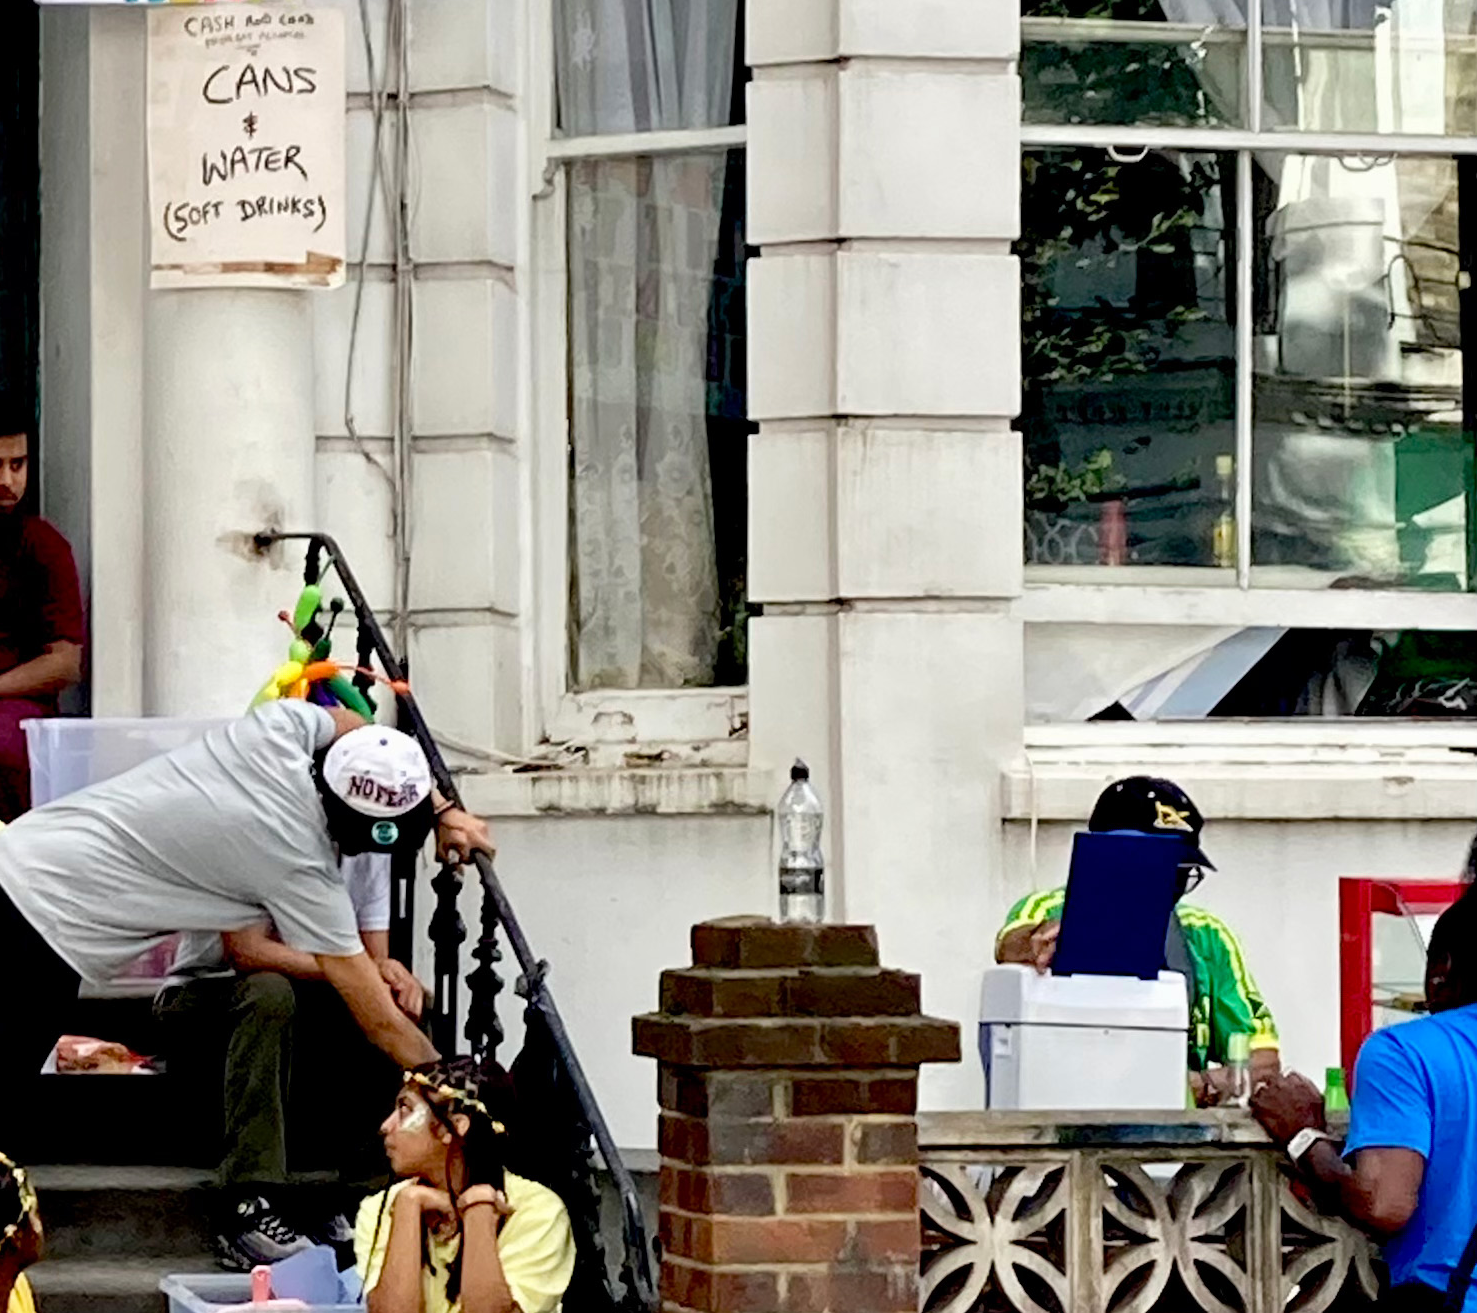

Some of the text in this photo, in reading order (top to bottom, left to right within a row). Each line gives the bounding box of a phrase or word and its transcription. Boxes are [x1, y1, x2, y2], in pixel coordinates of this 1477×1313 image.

[184, 15, 235, 37] CASH
[202, 63, 317, 105] CANS
[201, 144, 308, 186] WATER
[163, 195, 327, 242] (SOFT DRINKS)
